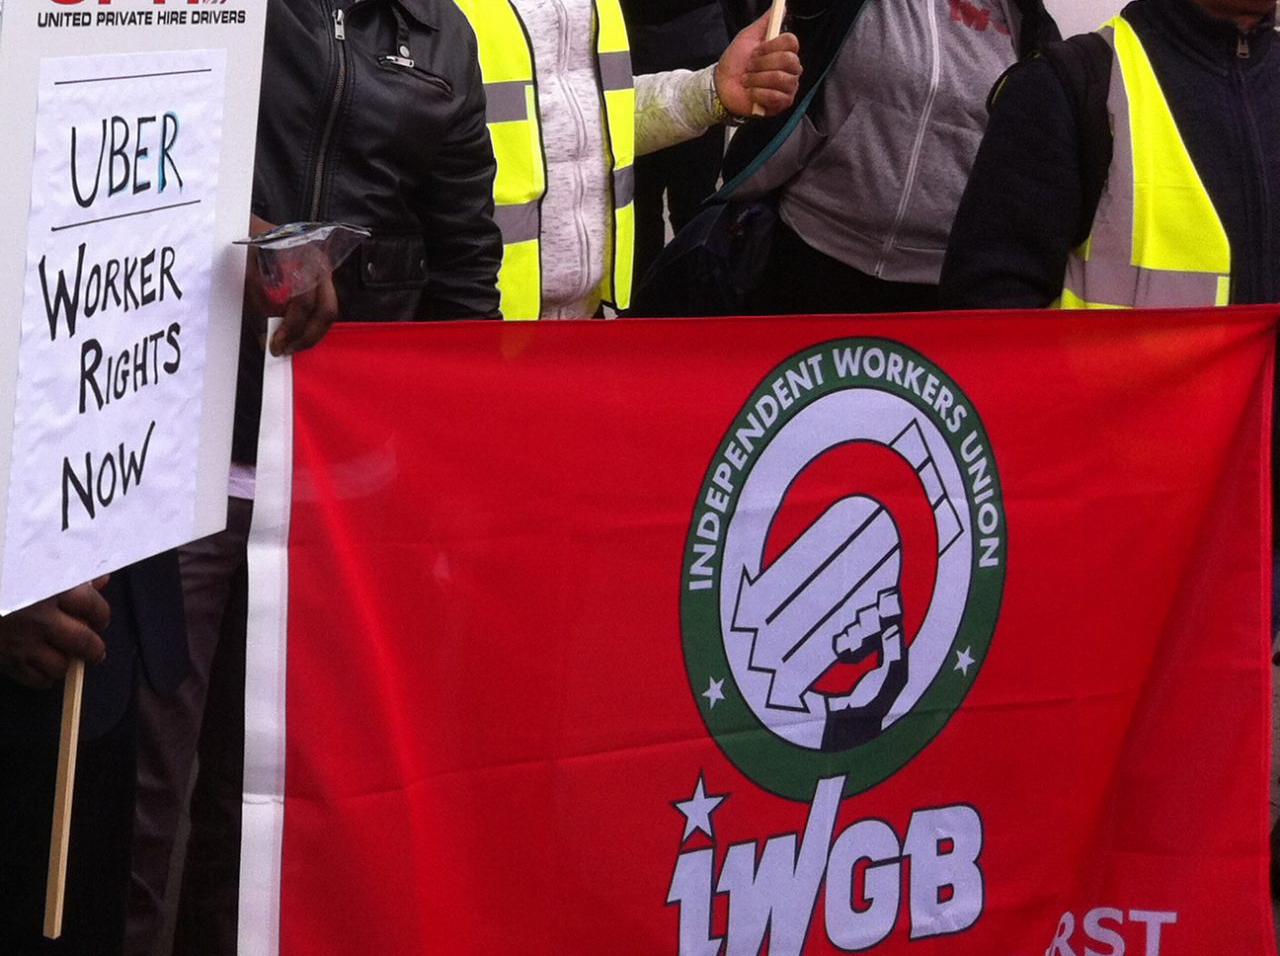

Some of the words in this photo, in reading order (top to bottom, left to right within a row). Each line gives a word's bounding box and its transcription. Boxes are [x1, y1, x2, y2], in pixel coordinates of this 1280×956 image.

[37, 12, 92, 28] UNITED
[96, 11, 153, 27] PRIVATE
[157, 11, 187, 25] HIRE
[191, 10, 246, 25] DRIVERS
[71, 111, 184, 209] UBER
[38, 242, 183, 342] WORKER
[78, 321, 182, 415] RIGHTS
[61, 420, 156, 532] NOW
[688, 353, 825, 591] INDEPENDENT
[832, 346, 968, 434] WORKERS
[959, 430, 1000, 569] UNION
